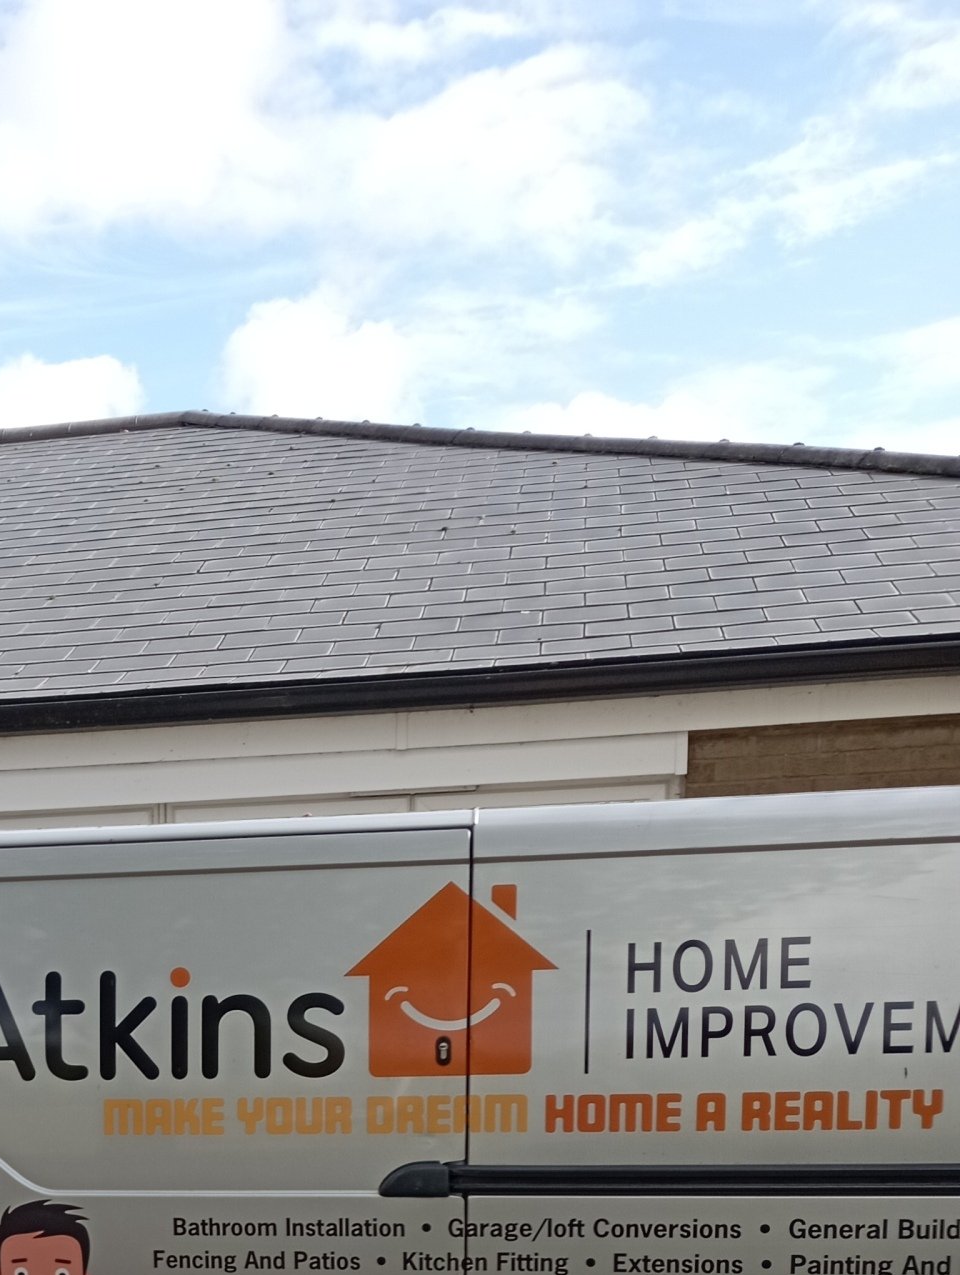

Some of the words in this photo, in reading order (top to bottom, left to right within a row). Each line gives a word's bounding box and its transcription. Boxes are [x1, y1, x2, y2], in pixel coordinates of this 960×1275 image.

[626, 936, 812, 994] HOME
[625, 1000, 960, 1060] IMPROVEM
[103, 1097, 224, 1136] MAKE
[236, 1096, 352, 1135] YOUR
[366, 1094, 528, 1135] DREAM
[545, 1092, 682, 1134] HOME
[695, 1092, 727, 1132] A
[739, 1089, 944, 1132] REALITY
[172, 1217, 278, 1238] Bathroom
[285, 1218, 406, 1238] Installation
[447, 1218, 586, 1242] Garage/loft
[593, 1218, 742, 1239] Conversions
[788, 1218, 888, 1240] General
[898, 1218, 960, 1240] Build
[152, 1250, 237, 1273] Fencing
[244, 1250, 286, 1270] And
[293, 1250, 361, 1271] Patios
[401, 1251, 488, 1272] Kitchen
[496, 1252, 569, 1275] Fitting
[613, 1253, 744, 1275] Extensions
[902, 1255, 951, 1275] And
